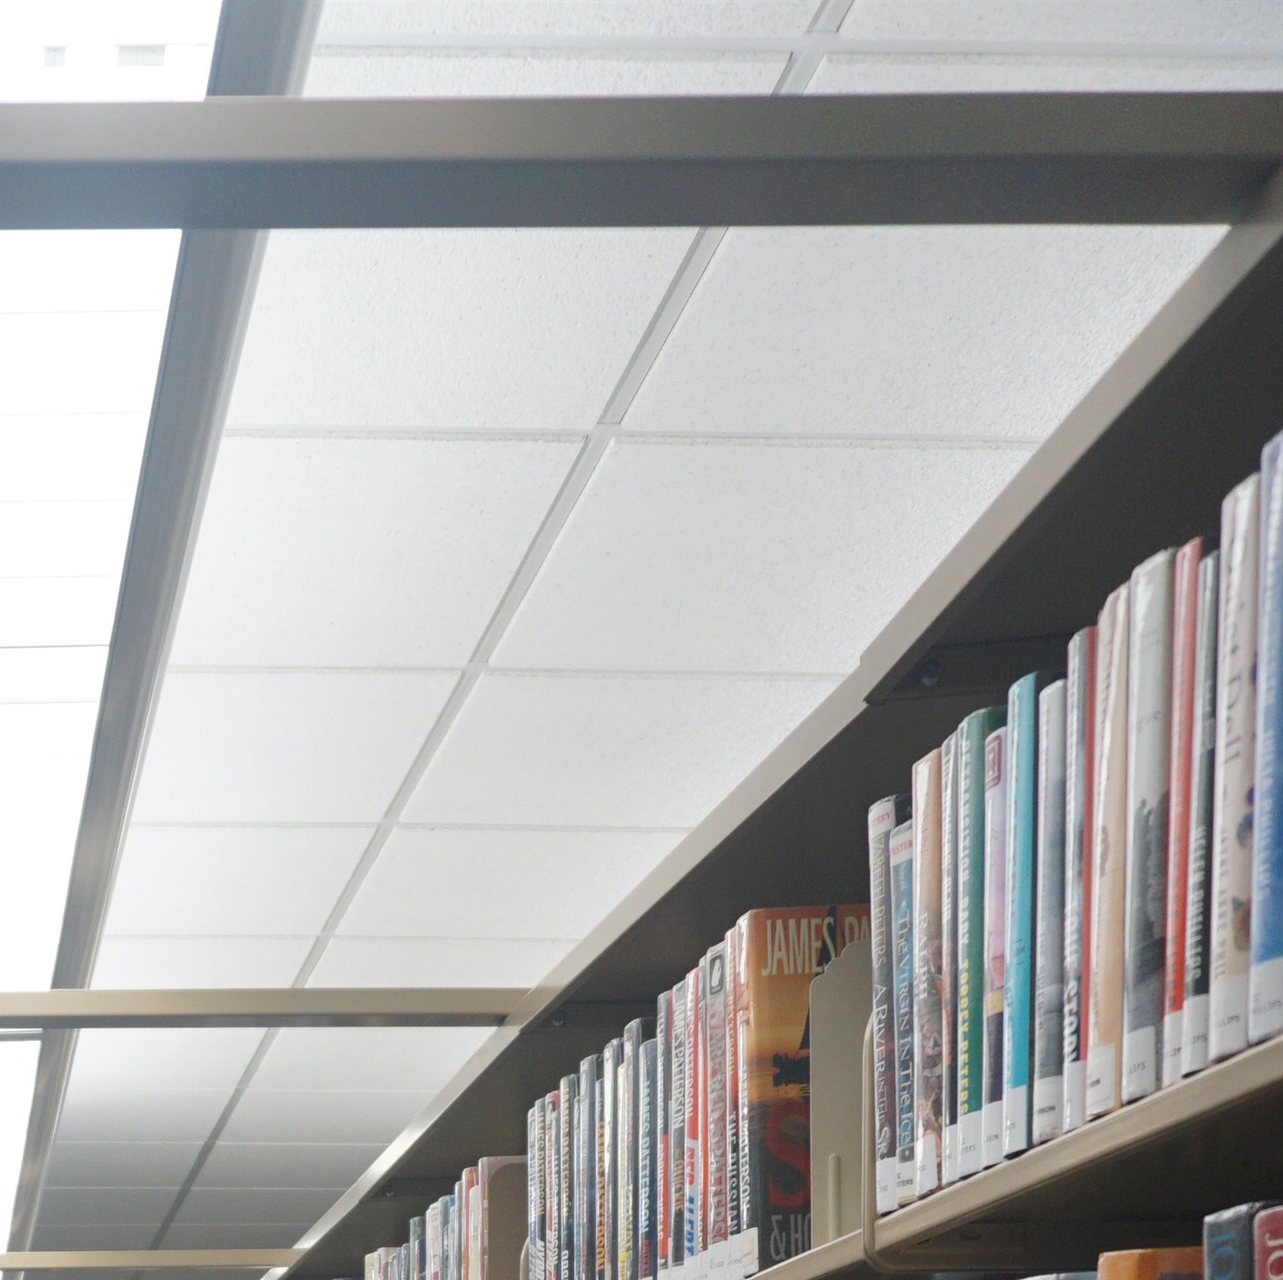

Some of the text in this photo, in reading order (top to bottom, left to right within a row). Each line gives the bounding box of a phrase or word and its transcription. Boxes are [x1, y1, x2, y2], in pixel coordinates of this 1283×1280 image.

[760, 918, 836, 978] JAMES
[673, 999, 686, 1130] JAMES PATTERSON
[874, 1004, 888, 1078] RIVER
[640, 1139, 651, 1234] PATTERSON
[728, 1152, 739, 1236] RUSSIAN
